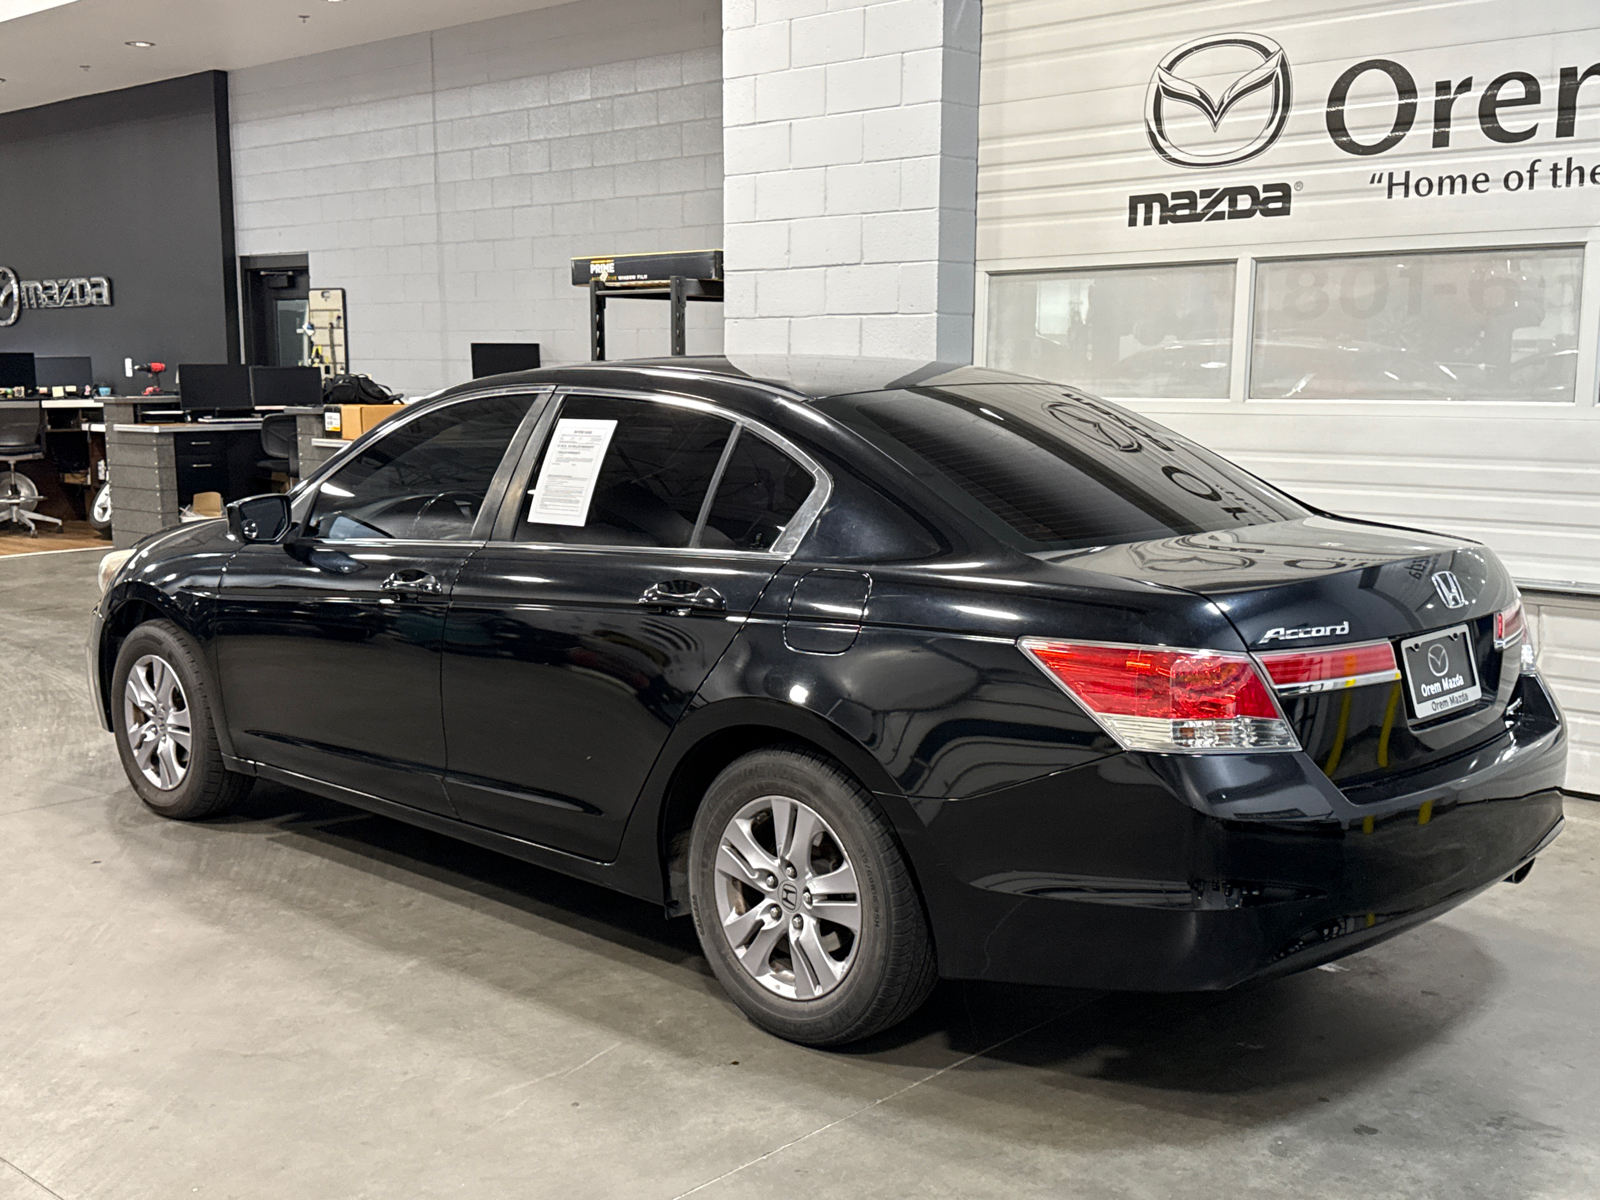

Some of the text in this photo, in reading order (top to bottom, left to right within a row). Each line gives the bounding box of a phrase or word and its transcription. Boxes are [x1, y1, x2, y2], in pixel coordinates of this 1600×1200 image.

[1502, 158, 1542, 192] of
[590, 262, 616, 274] PRIME
[1257, 620, 1350, 645] Accord
[1420, 673, 1465, 697] Orem Mazda
[1431, 692, 1469, 711] Orem Mazda
